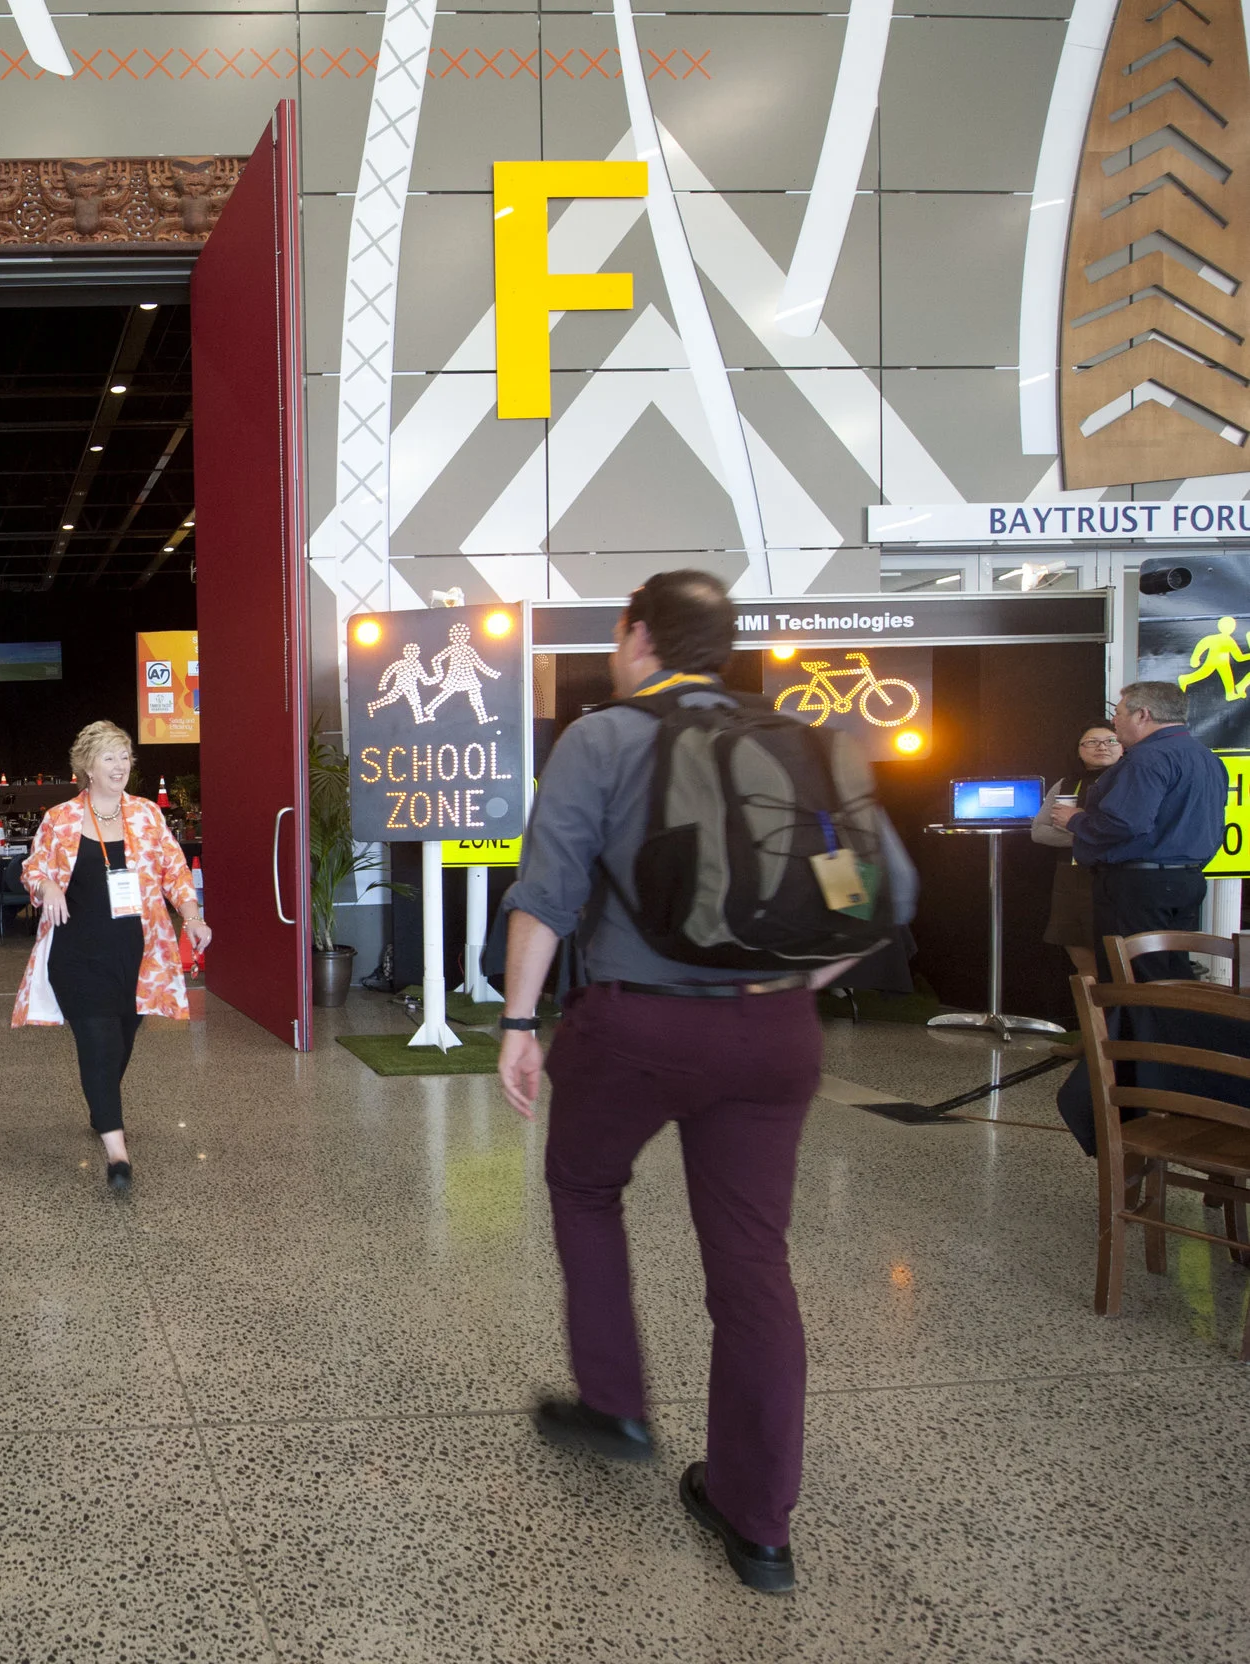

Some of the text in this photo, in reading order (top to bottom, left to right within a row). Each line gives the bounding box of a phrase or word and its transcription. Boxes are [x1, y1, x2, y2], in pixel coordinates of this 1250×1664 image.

[494, 161, 648, 419] F
[989, 506, 1161, 534] BAYTRUST
[776, 612, 915, 632] Technologies
[360, 741, 512, 784] SCHOOL
[385, 788, 485, 829] ZONE
